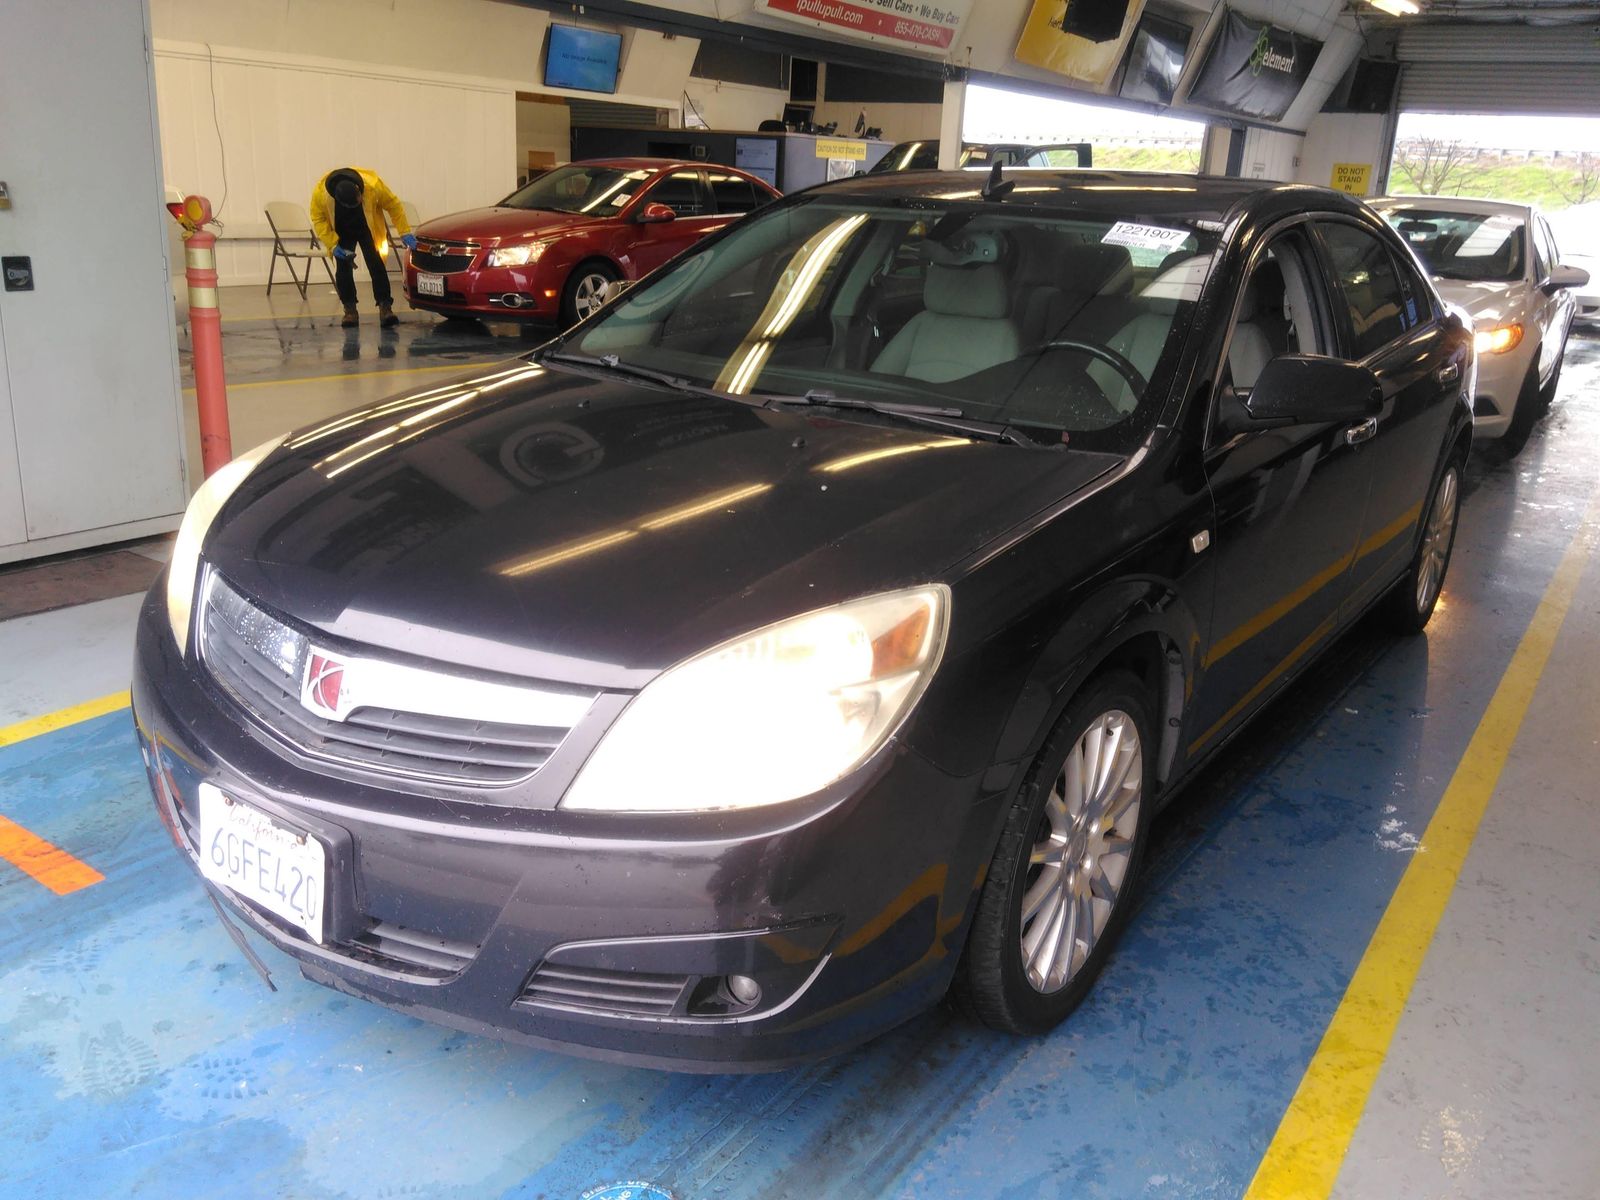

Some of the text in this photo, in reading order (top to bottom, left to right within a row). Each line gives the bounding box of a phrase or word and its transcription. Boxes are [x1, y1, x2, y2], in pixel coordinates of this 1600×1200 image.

[895, 0, 914, 13] Cars
[920, 4, 931, 17] We
[932, 8, 945, 23] Buy
[1263, 47, 1295, 73] element
[1337, 167, 1365, 175] DO NOT
[1116, 224, 1181, 241] 1221907
[211, 827, 317, 920] 6GFE420
